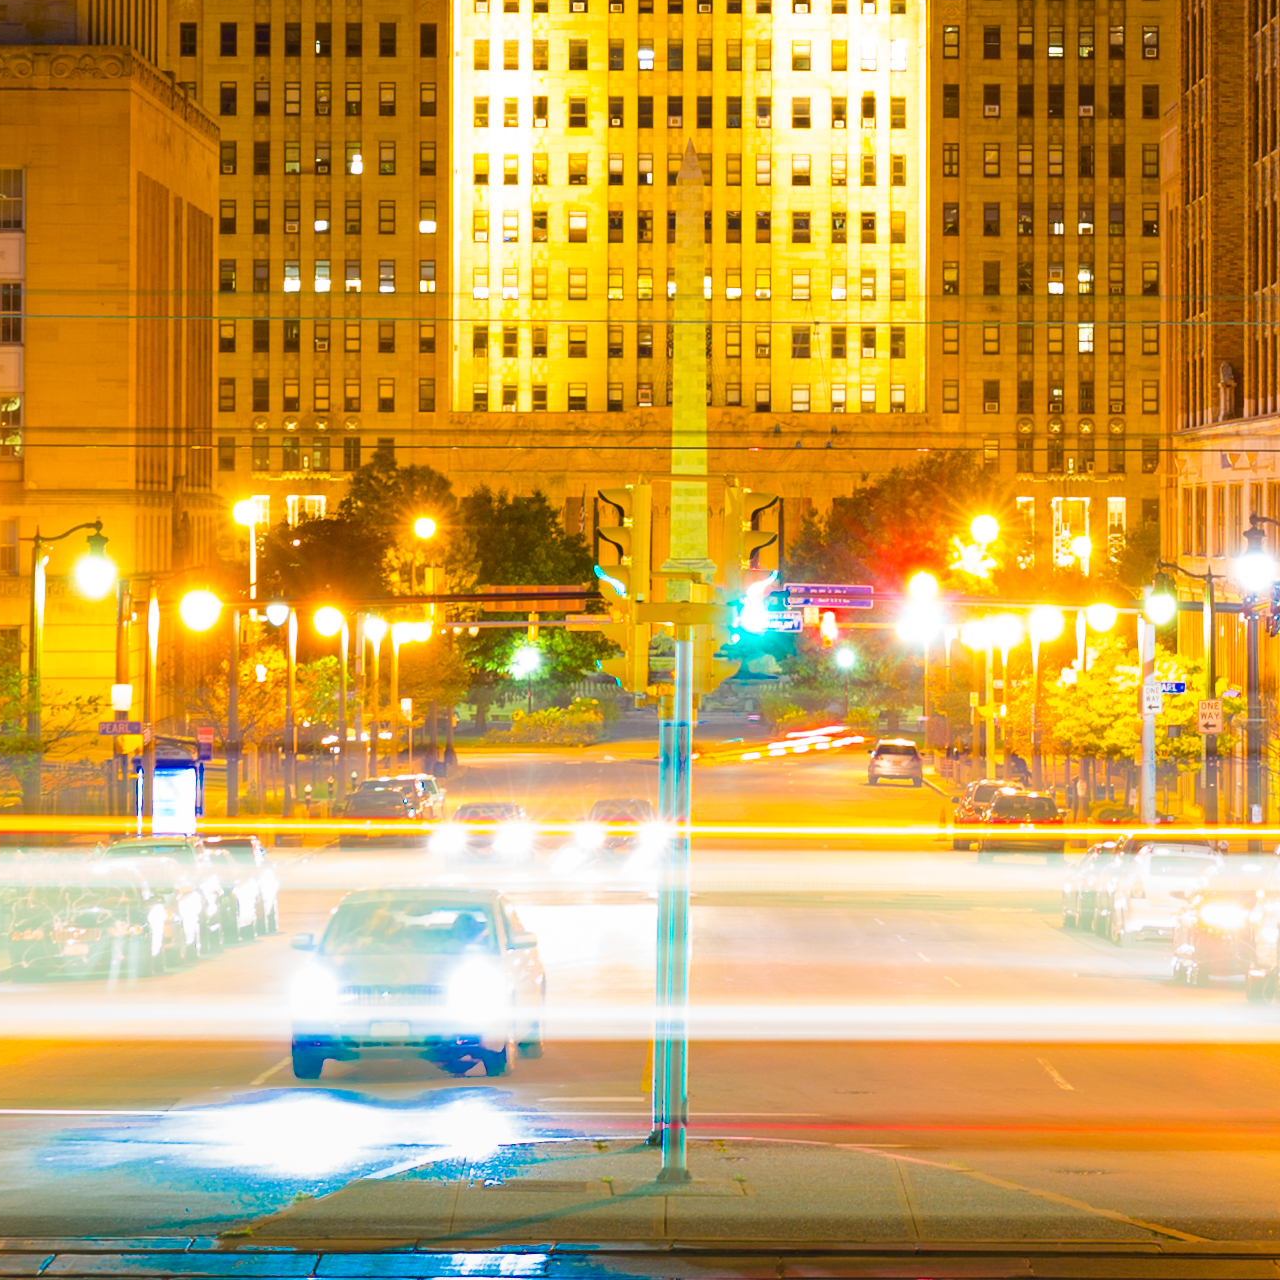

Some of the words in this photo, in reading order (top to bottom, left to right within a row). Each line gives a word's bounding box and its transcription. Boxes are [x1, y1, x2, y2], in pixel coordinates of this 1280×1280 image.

[1145, 687, 1159, 695] ONE
[1200, 702, 1219, 710] ONE
[1200, 712, 1220, 720] WAY
[100, 723, 131, 733] PEARL
